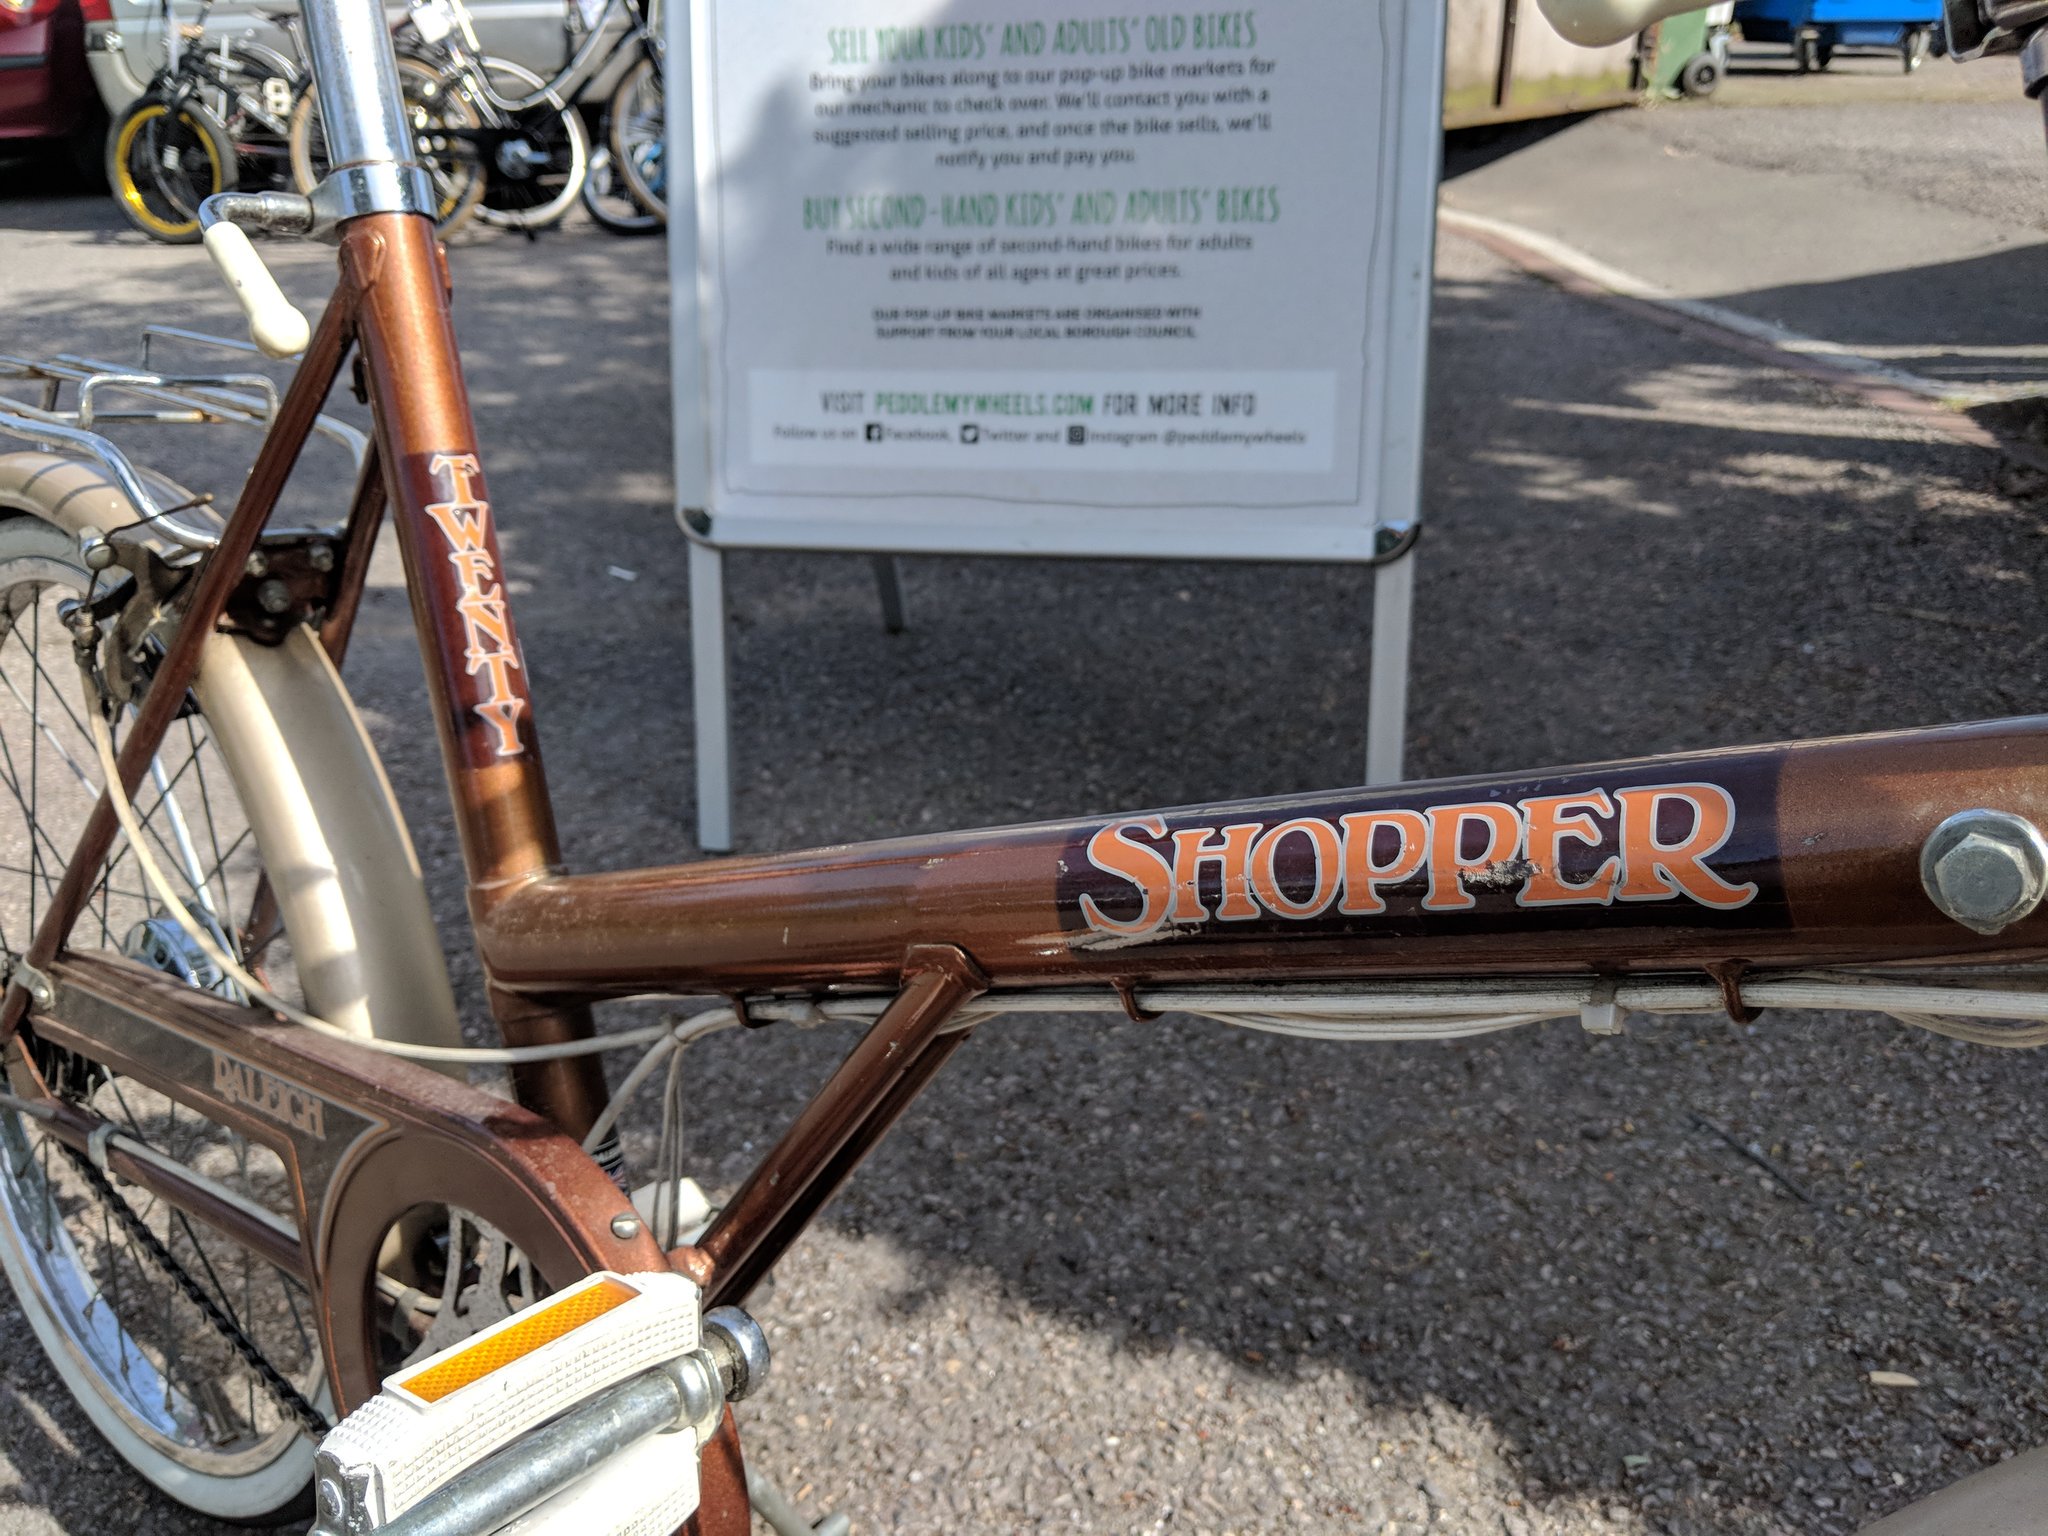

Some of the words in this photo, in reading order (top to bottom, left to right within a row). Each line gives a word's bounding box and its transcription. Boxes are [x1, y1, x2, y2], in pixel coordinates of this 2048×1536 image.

[830, 27, 868, 63] SELL
[877, 25, 928, 62] YOUR
[935, 22, 994, 60] KIDS'
[1002, 20, 1047, 57] AND
[1147, 14, 1188, 52] OLD
[1195, 9, 1258, 50] BIKES
[811, 71, 854, 93] Bring
[860, 74, 897, 93] your
[902, 70, 947, 89] bikes
[952, 70, 999, 90] along
[1004, 70, 1023, 85] to
[1028, 69, 1055, 83] our
[1061, 65, 1126, 84] pop-up
[1130, 61, 1168, 80] bike
[1173, 58, 1245, 78] markets
[1251, 56, 1276, 74] for
[817, 102, 843, 117] our
[849, 98, 929, 116] mechanic
[934, 99, 953, 113] to
[957, 96, 1004, 113] check
[1105, 92, 1171, 108] contact
[1176, 93, 1209, 111] you
[1214, 87, 1254, 105] with
[1259, 88, 1271, 102] a
[815, 125, 900, 147] suggested
[906, 123, 962, 144] selling
[1018, 121, 1051, 138] and
[1055, 121, 1097, 136] once
[1101, 118, 1129, 135] the
[1135, 117, 1171, 134] bike
[937, 150, 986, 169] notify
[991, 151, 1024, 169] you
[1028, 148, 1061, 165] and
[1065, 148, 1097, 168] pay
[804, 194, 841, 231] BUY
[848, 191, 1000, 230] SECOND-HAND
[1007, 191, 1065, 227] KIDS'
[1073, 191, 1118, 225] AND
[1218, 187, 1282, 224] BIKES
[828, 238, 865, 256] Find
[868, 240, 878, 256] a
[882, 238, 921, 256] wide
[927, 239, 970, 259] range
[978, 237, 996, 255] of
[1002, 236, 1111, 255] second-hand
[1117, 236, 1162, 252] bikes
[1169, 235, 1192, 250] for
[1199, 234, 1254, 251] adults
[890, 264, 920, 282] and
[925, 264, 960, 281] kids
[964, 264, 982, 281] of
[988, 263, 1008, 280] all
[1012, 265, 1051, 285] ages
[1057, 265, 1072, 278] at
[1077, 265, 1122, 284] great
[874, 308, 900, 321] OUR
[958, 308, 984, 321] BIKE
[990, 308, 1050, 321] MARKETS
[1057, 308, 1081, 320] ARE
[1089, 307, 1162, 320] ORGANISED
[1168, 307, 1201, 320] WITH
[878, 326, 934, 339] SUPPORT
[940, 326, 976, 339] FROM
[982, 326, 1014, 339] YOUR
[1019, 326, 1061, 339] LOCAL
[1066, 326, 1131, 339] BOROUGH
[822, 391, 866, 415] VISIT
[876, 391, 1096, 416] PEDDLEMYWHEELS.COM
[1103, 392, 1139, 416] FOR
[1149, 392, 1203, 417] MORE
[1213, 392, 1257, 417] INFO
[775, 425, 818, 443] Follow
[822, 428, 837, 441] us
[844, 429, 859, 441] on
[985, 428, 1030, 444] Twitter
[1036, 428, 1061, 443] and
[1089, 429, 1158, 447] Instagram
[1164, 429, 1307, 448] @peddlemywheels
[425, 453, 524, 756] TWENTY
[1078, 780, 1760, 938] SHOPPER
[213, 1051, 327, 1141] RALEIGH
